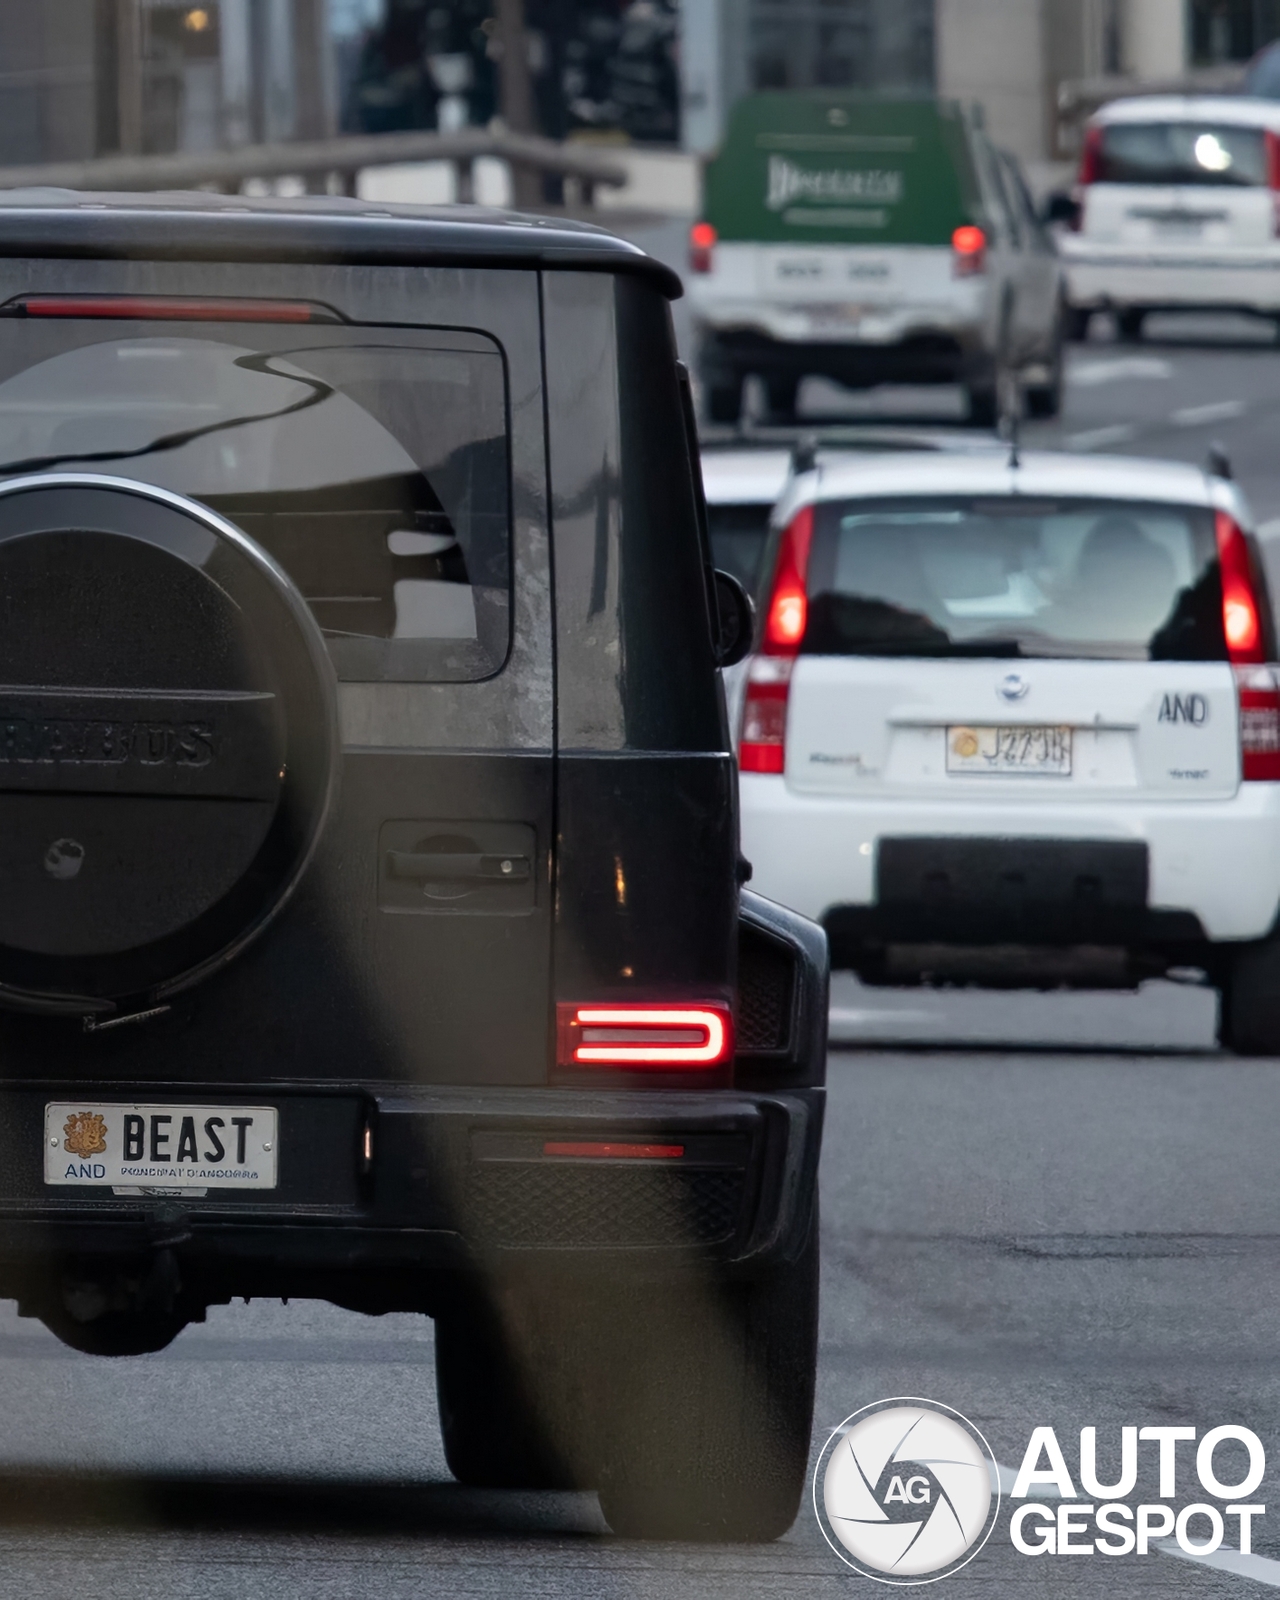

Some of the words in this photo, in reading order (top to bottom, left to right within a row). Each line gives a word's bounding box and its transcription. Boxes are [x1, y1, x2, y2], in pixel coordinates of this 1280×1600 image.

[1157, 692, 1208, 725] AND
[122, 1114, 254, 1164] BEAST
[64, 1163, 106, 1179] AND
